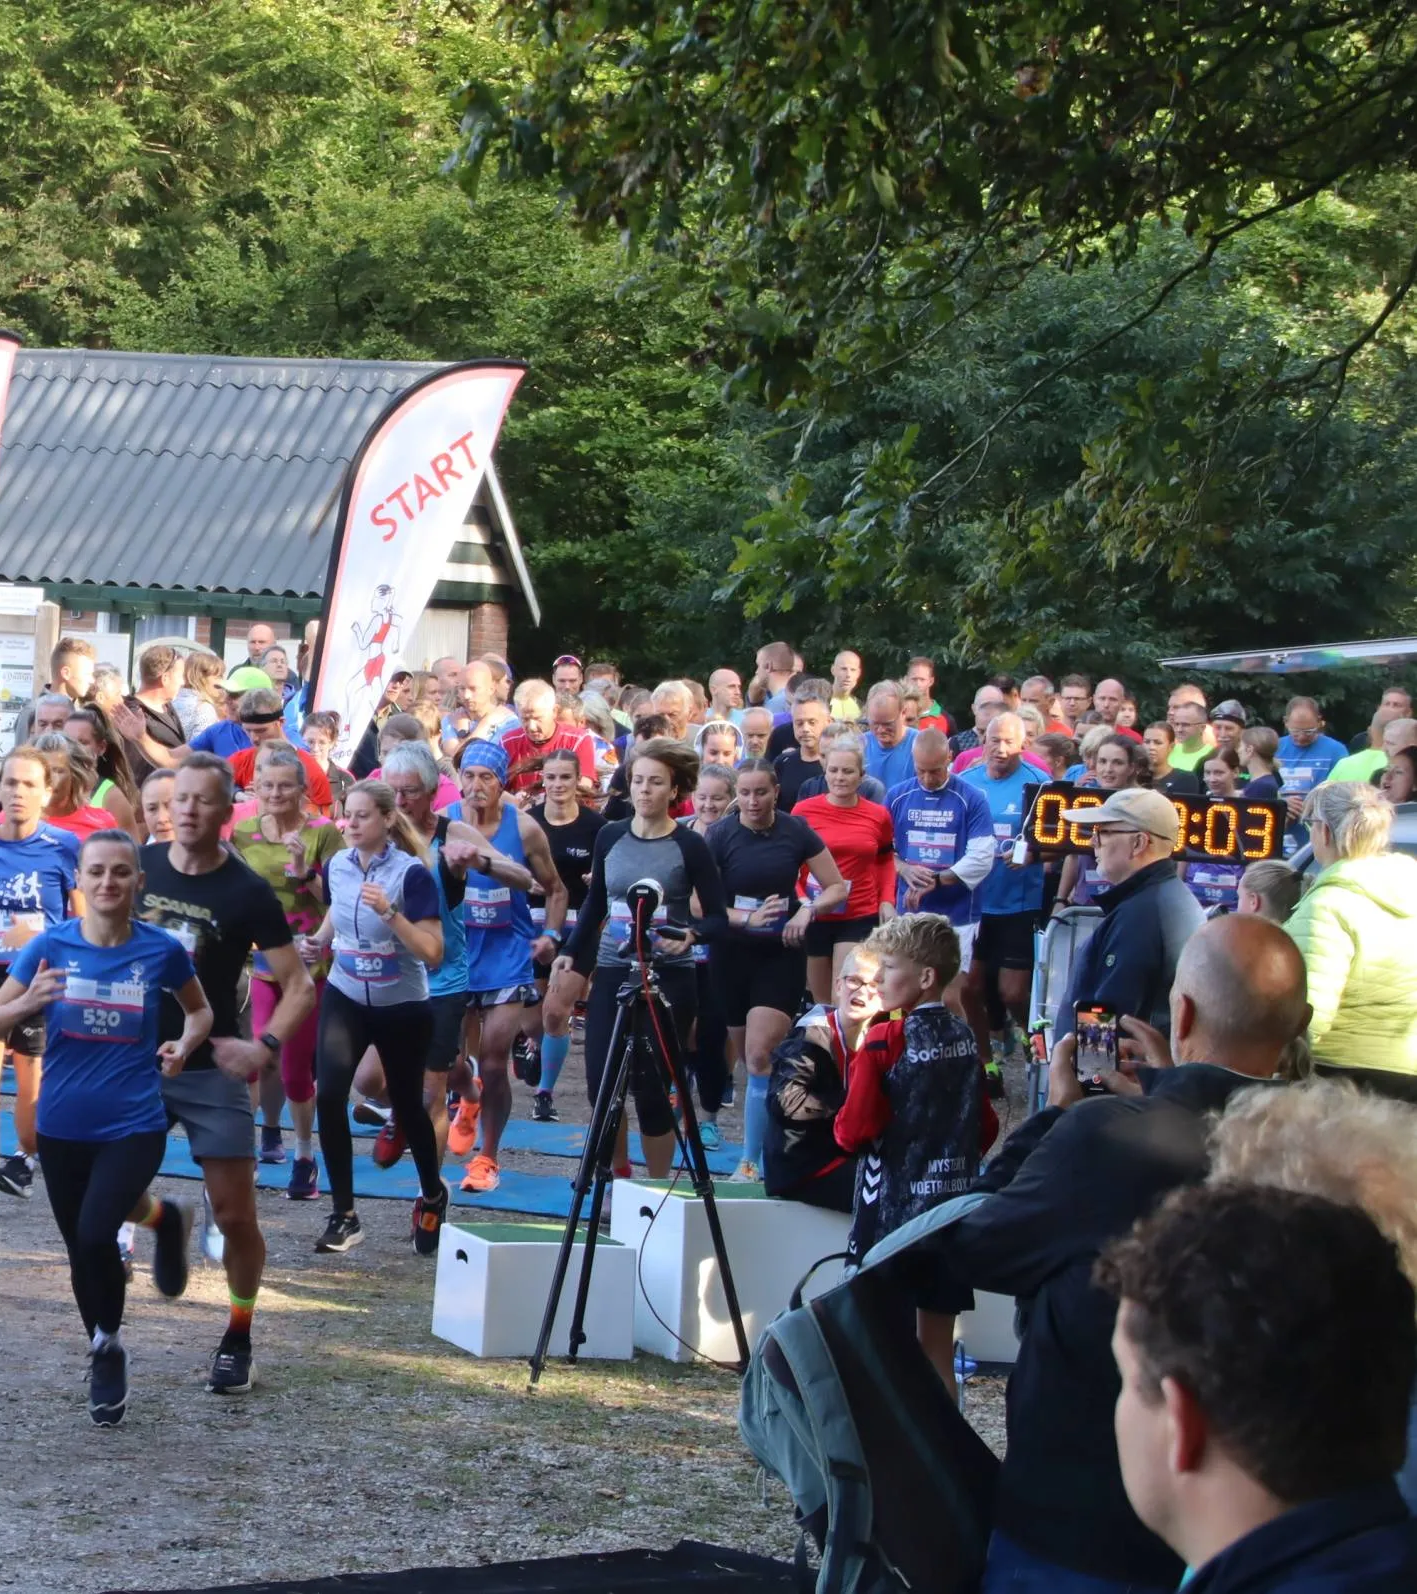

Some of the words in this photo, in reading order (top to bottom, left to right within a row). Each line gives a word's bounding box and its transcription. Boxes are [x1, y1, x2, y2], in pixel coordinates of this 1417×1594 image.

[370, 431, 476, 542] START
[143, 893, 212, 922] SCANIA
[355, 957, 383, 971] 550
[83, 1008, 121, 1027] 520
